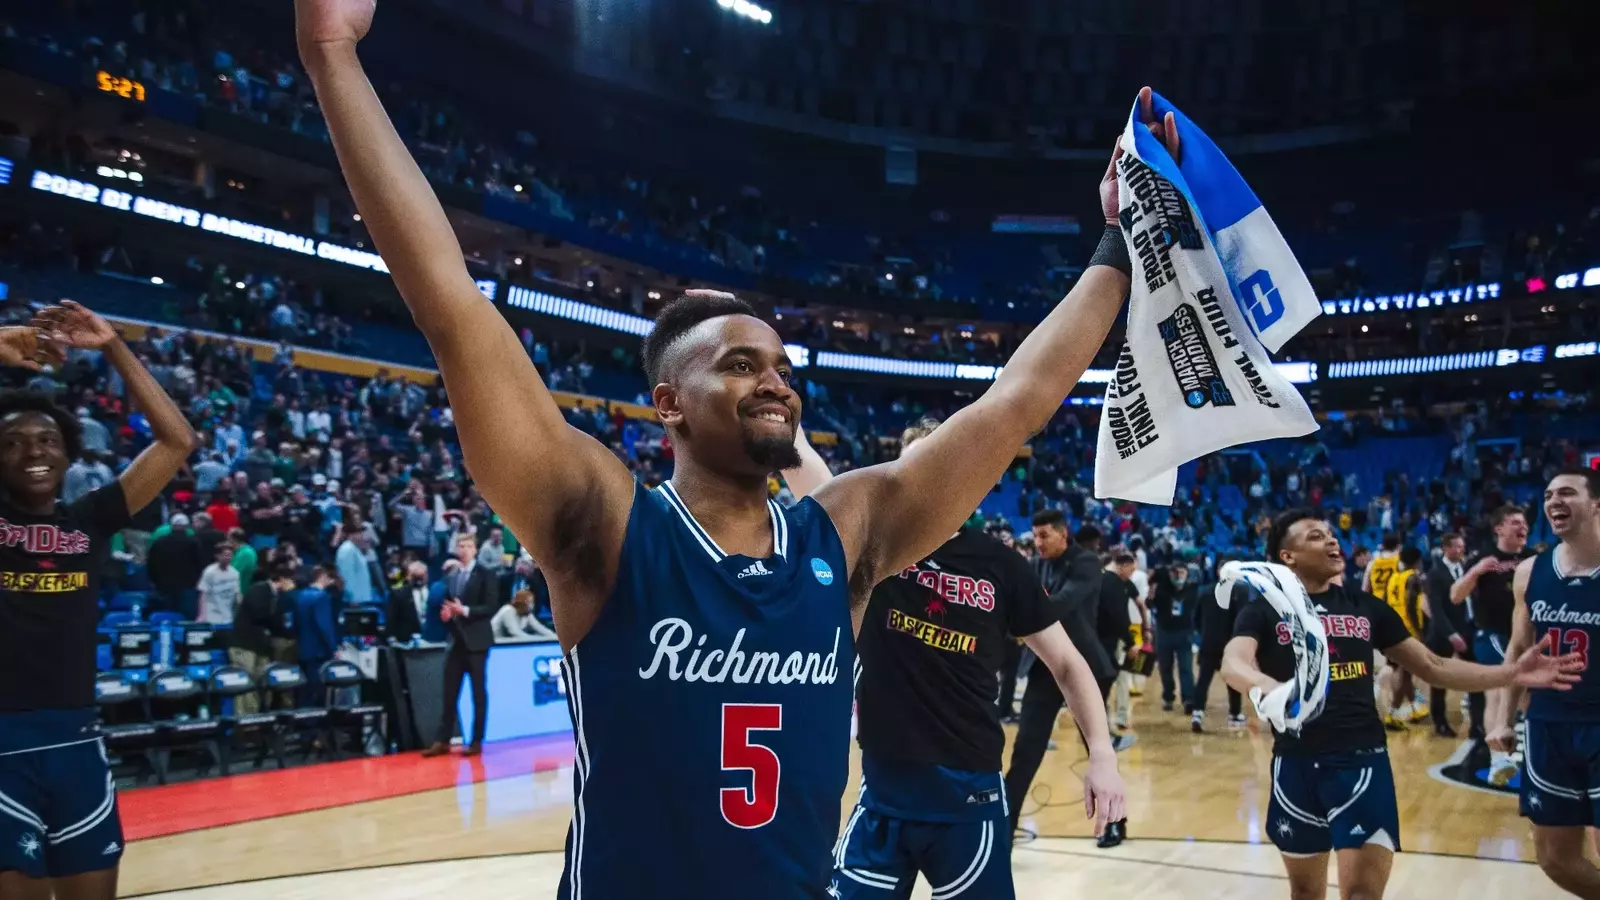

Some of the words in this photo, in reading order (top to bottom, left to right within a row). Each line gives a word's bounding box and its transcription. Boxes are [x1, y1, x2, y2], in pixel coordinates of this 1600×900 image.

[96, 70, 146, 102] 5:27
[31, 169, 100, 203] 2022
[133, 195, 201, 227] MEN'S
[201, 212, 317, 256] BASKETBALL
[1133, 229, 1162, 283] ROAD
[1147, 276, 1167, 294] THE
[1168, 340, 1202, 392] MARCH
[1174, 306, 1215, 379] MADNESS
[1107, 406, 1136, 451] ROAD
[1124, 392, 1159, 450] FINAL
[1117, 444, 1139, 461] THE
[887, 609, 978, 655] BASKETBALL
[1531, 600, 1600, 626] Richmon
[638, 617, 842, 686] Richmond
[1547, 627, 1590, 673] 13
[719, 702, 784, 831] 5
